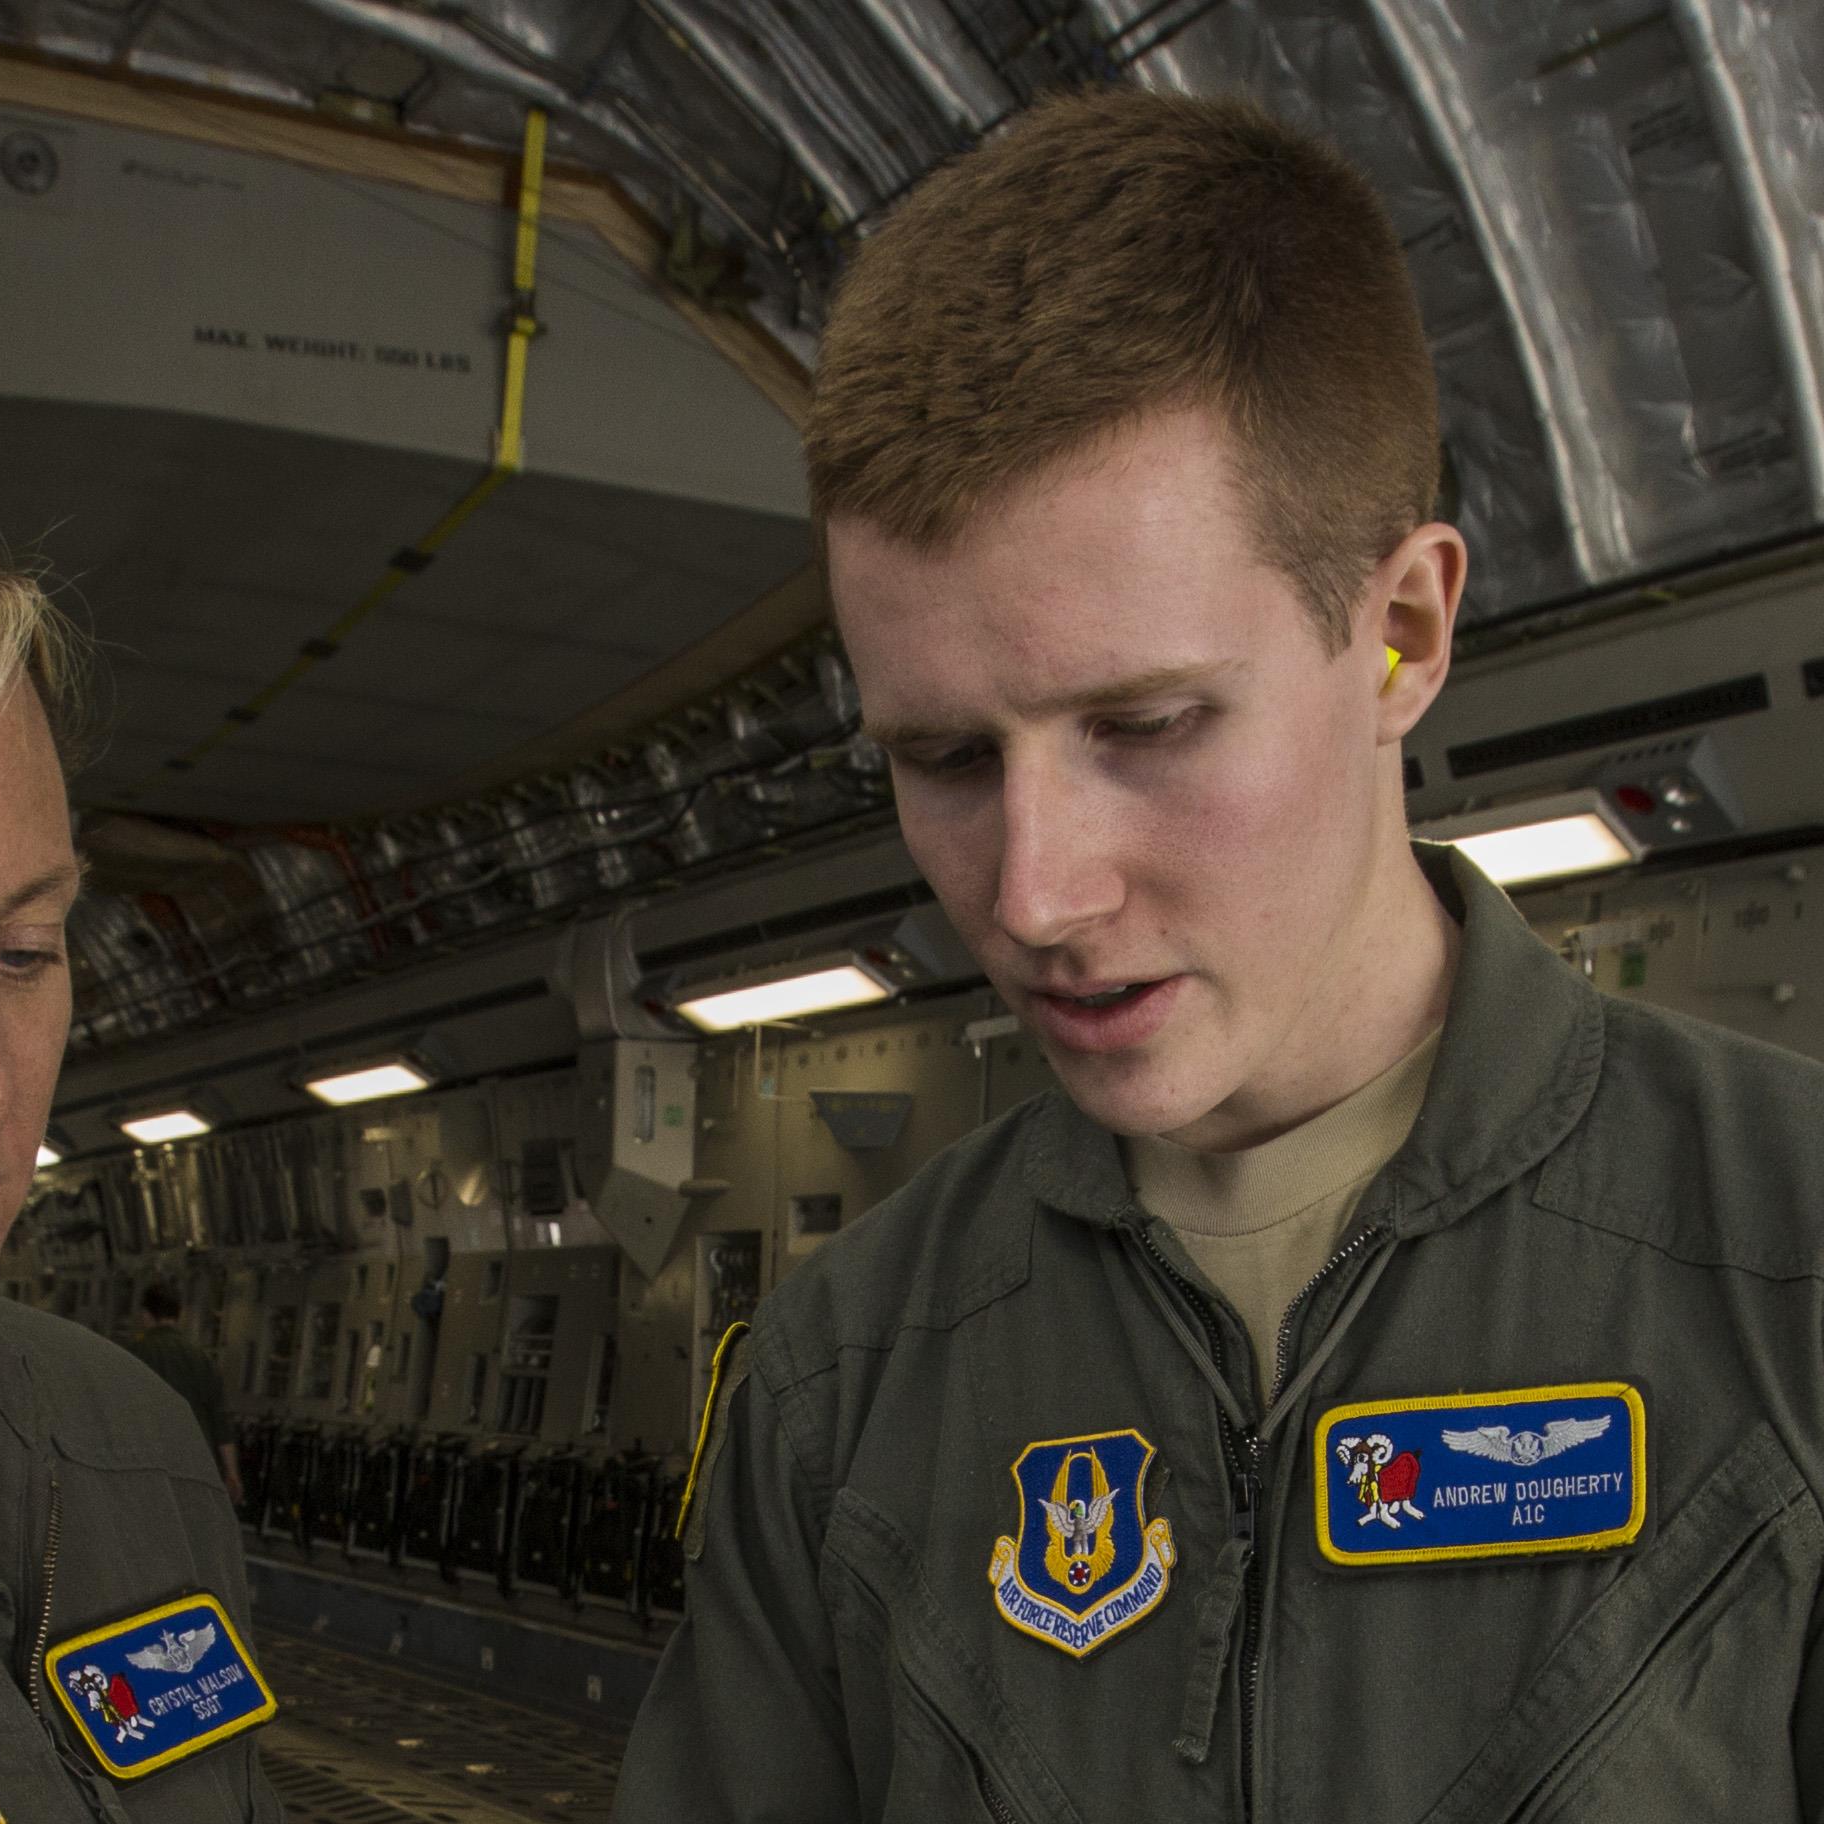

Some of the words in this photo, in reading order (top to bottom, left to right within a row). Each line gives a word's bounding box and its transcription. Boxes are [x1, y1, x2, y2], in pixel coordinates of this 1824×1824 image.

[1432, 1482, 1508, 1509] ANDREW
[1515, 1472, 1624, 1502] DOUGHERTY
[1511, 1503, 1546, 1526] A1C
[998, 1575, 1019, 1611] AIR
[1014, 1596, 1052, 1632] FORCE
[1051, 1611, 1105, 1649] RESERVE
[1104, 1562, 1163, 1626] COMMAND
[147, 1682, 202, 1717] CRYSTAL
[192, 1694, 224, 1720] SSGT
